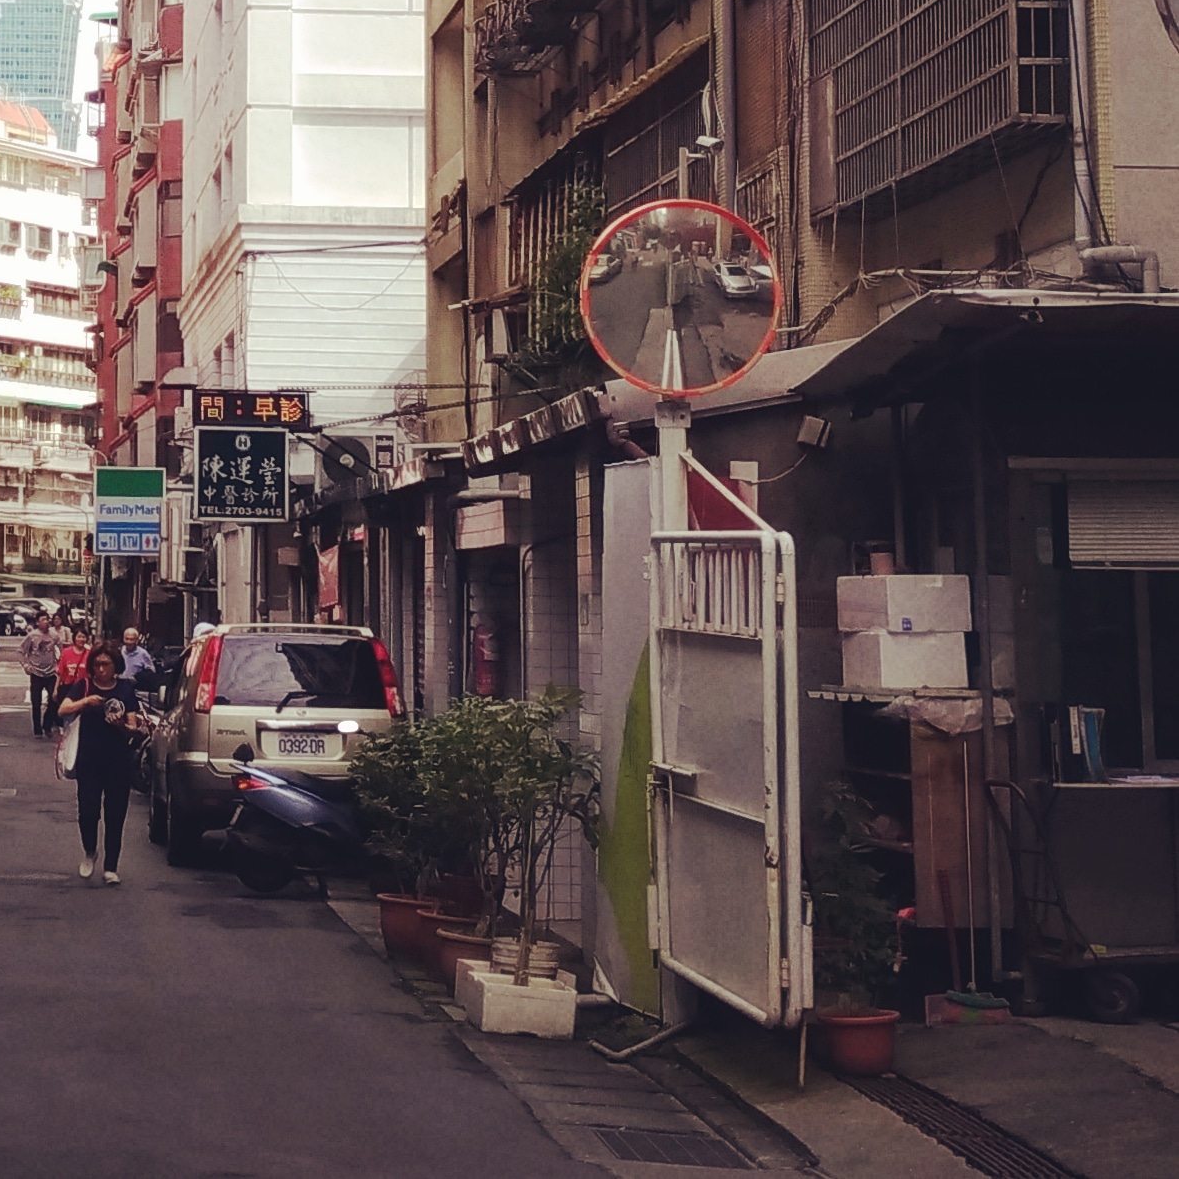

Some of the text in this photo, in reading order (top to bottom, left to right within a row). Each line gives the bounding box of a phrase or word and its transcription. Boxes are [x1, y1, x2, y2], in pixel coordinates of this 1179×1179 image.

[203, 485, 279, 506] 中醫診所
[99, 504, 160, 517] FamilyMart
[122, 535, 139, 548] ATM
